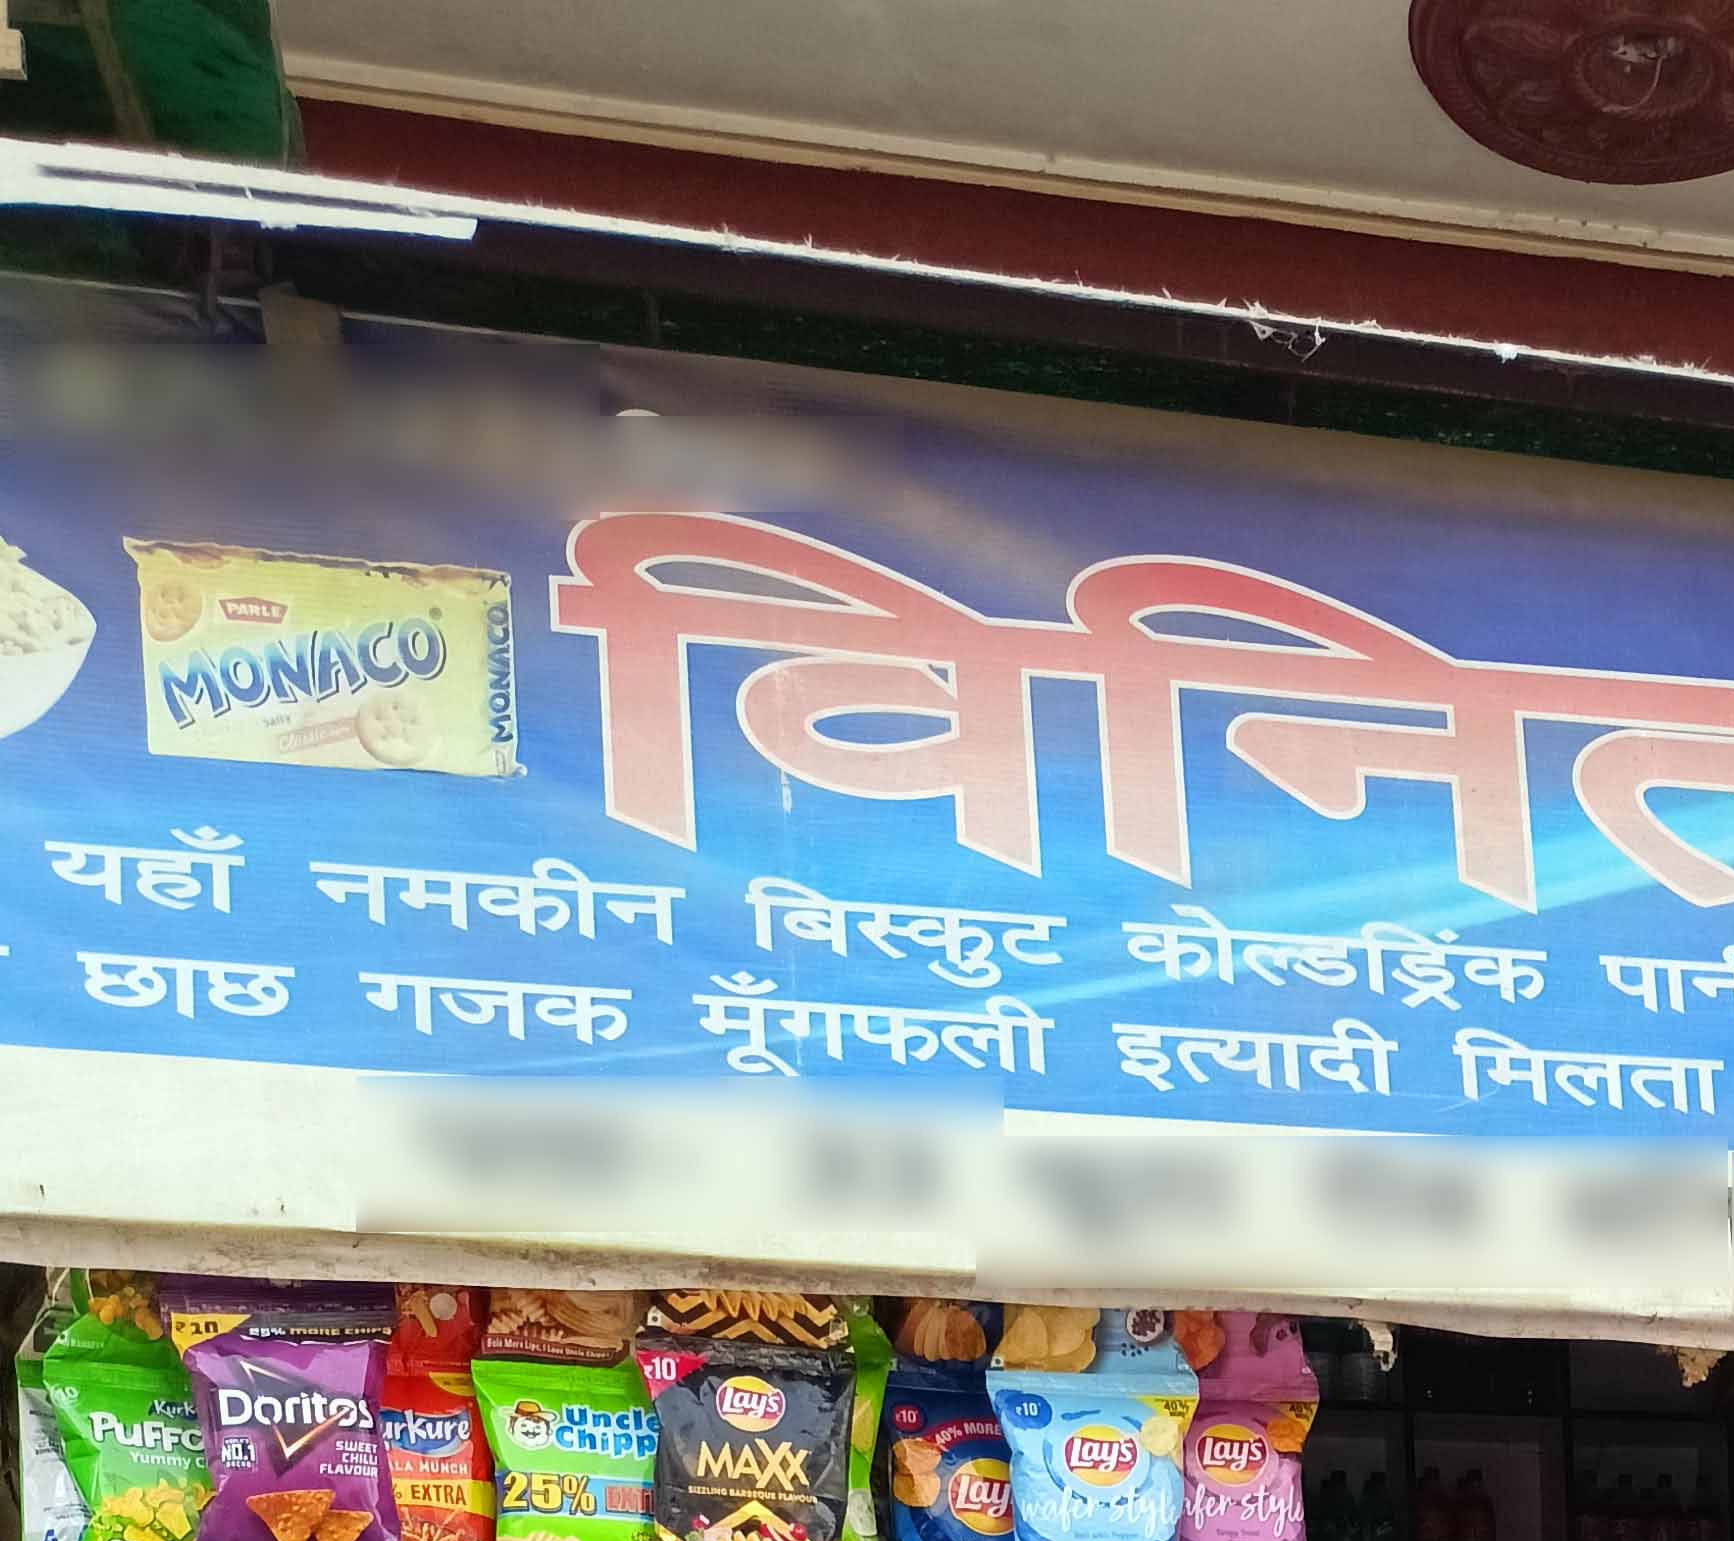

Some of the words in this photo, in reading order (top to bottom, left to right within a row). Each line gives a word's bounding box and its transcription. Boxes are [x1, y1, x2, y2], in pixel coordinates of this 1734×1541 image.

[226, 601, 281, 621] PARLE
[156, 617, 445, 726] MONACO
[487, 600, 510, 744] MONACO
[44, 826, 245, 914] यहाँ
[309, 858, 686, 944] नमकीन
[746, 877, 1066, 989] बिस्कुट
[1122, 905, 1547, 1012] कोल्डड्रिंक
[76, 951, 295, 1018] छाछ
[359, 972, 632, 1044] गजक
[693, 972, 1056, 1076] मूँगफली
[1112, 1019, 1398, 1095] इत्यादी
[1453, 1030, 1723, 1116] मिलता
[218, 1389, 373, 1428] Doritos
[723, 1387, 781, 1418] Lay's
[566, 1408, 661, 1430] Uncle
[336, 1441, 377, 1453] SWEET
[342, 1454, 378, 1464] CHILLI
[1069, 1437, 1135, 1470] Lay's
[1202, 1437, 1263, 1470] Lay's
[320, 1464, 378, 1477] FLAVOUR
[420, 1461, 468, 1474] MUNCH
[411, 1484, 467, 1506] EXTRA
[503, 1472, 597, 1515] 25%
